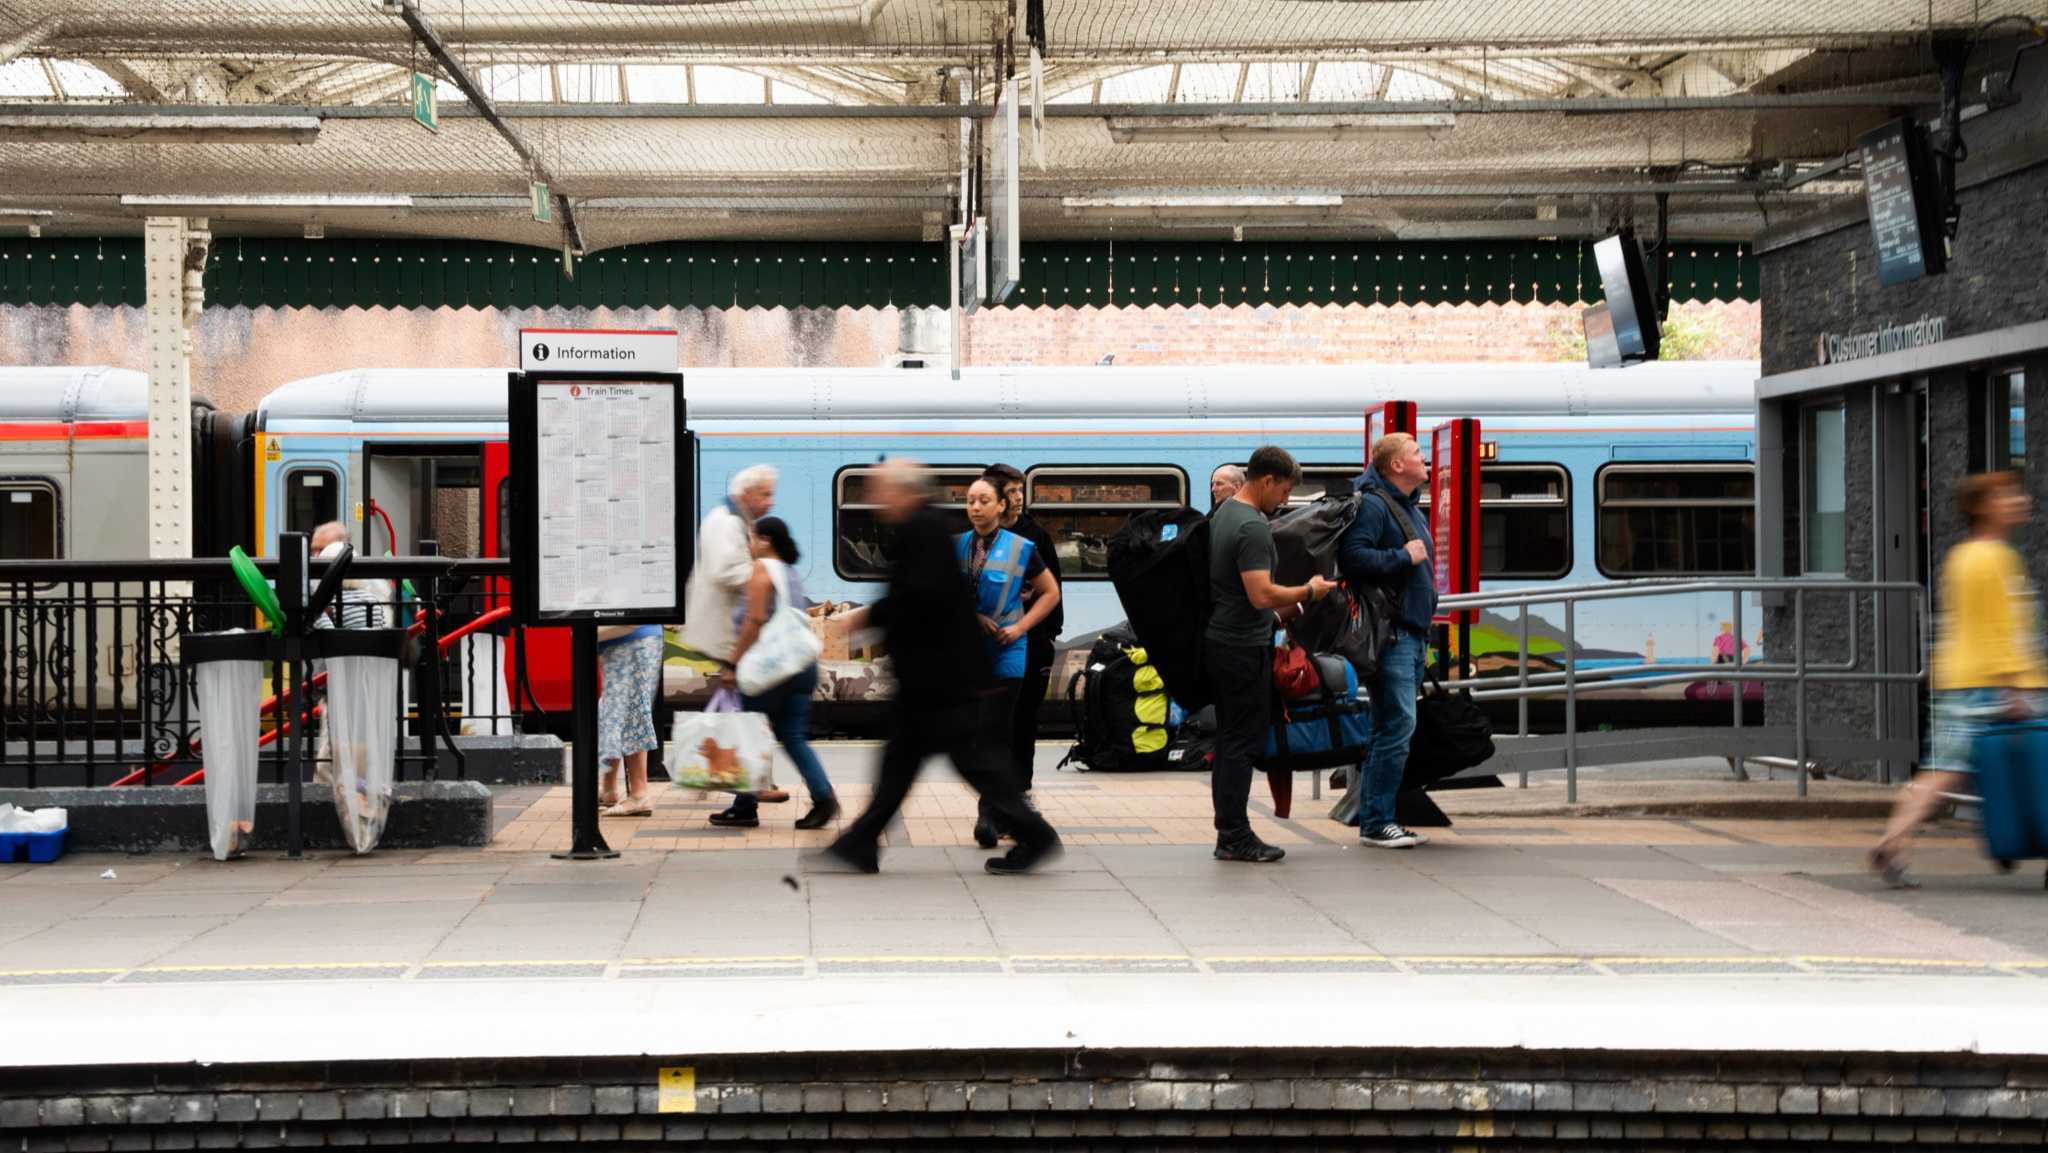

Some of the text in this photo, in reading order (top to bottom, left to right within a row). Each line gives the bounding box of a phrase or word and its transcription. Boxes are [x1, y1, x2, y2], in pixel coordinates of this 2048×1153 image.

[1829, 313, 1943, 364] Customer Information
[557, 346, 636, 360] Information
[586, 387, 634, 396] Train Times
